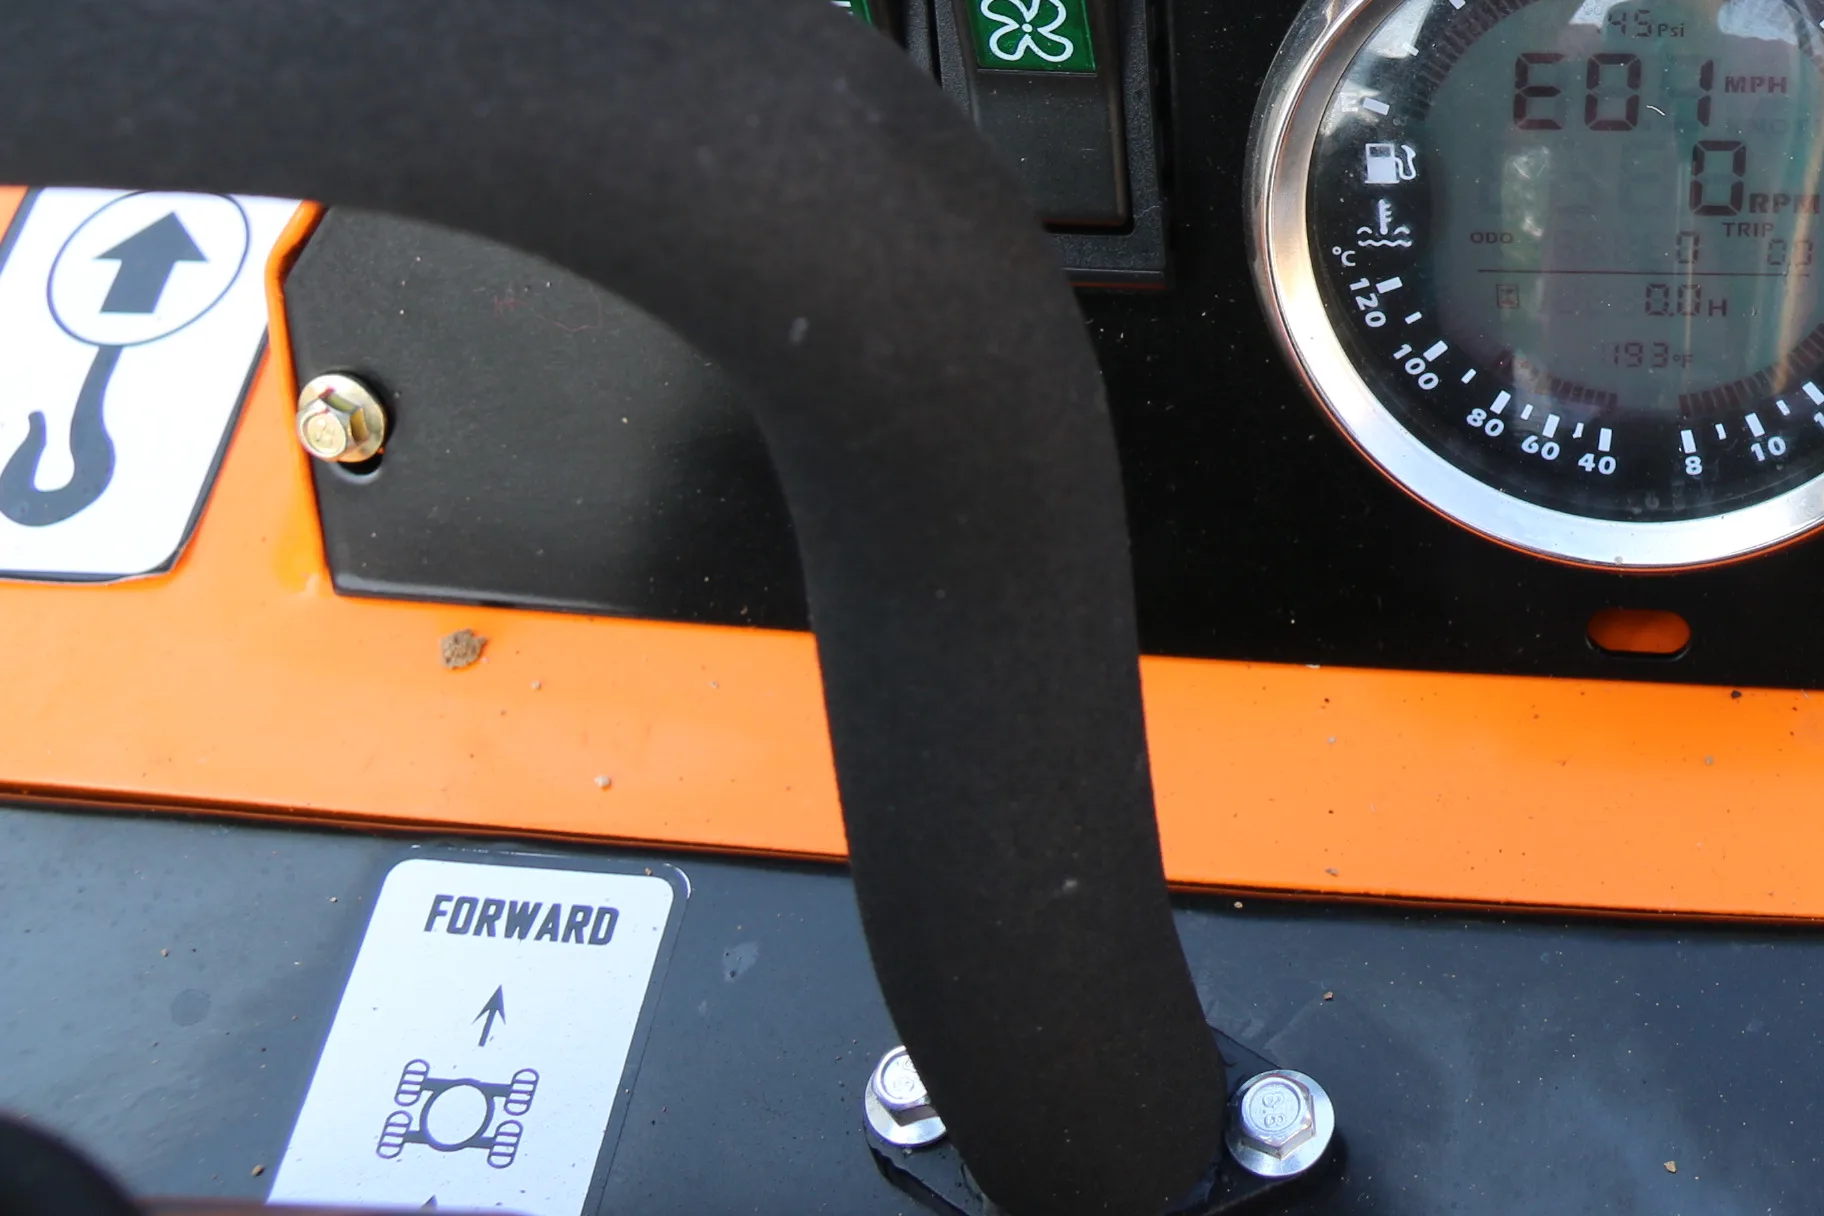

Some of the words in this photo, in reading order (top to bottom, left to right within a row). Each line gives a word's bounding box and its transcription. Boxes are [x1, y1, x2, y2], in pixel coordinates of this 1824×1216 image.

[1657, 20, 1686, 38] Psi
[1513, 52, 1714, 132] E01
[1724, 76, 1788, 94] MPH
[1689, 140, 1747, 216] 0
[1748, 192, 1821, 215] RPM
[1470, 231, 1514, 245] ODO
[1722, 221, 1775, 238] TRIP
[1332, 246, 1356, 267] °C
[1350, 277, 1387, 328] 120
[1708, 298, 1728, 317] H
[1393, 344, 1439, 390] 100
[1614, 342, 1669, 368] 193
[1466, 408, 1505, 437] 80
[1521, 435, 1560, 460] 60
[1750, 436, 1786, 462] 10
[1577, 453, 1617, 475] 40
[1684, 456, 1703, 476] 8
[423, 893, 620, 946] FORWARD
